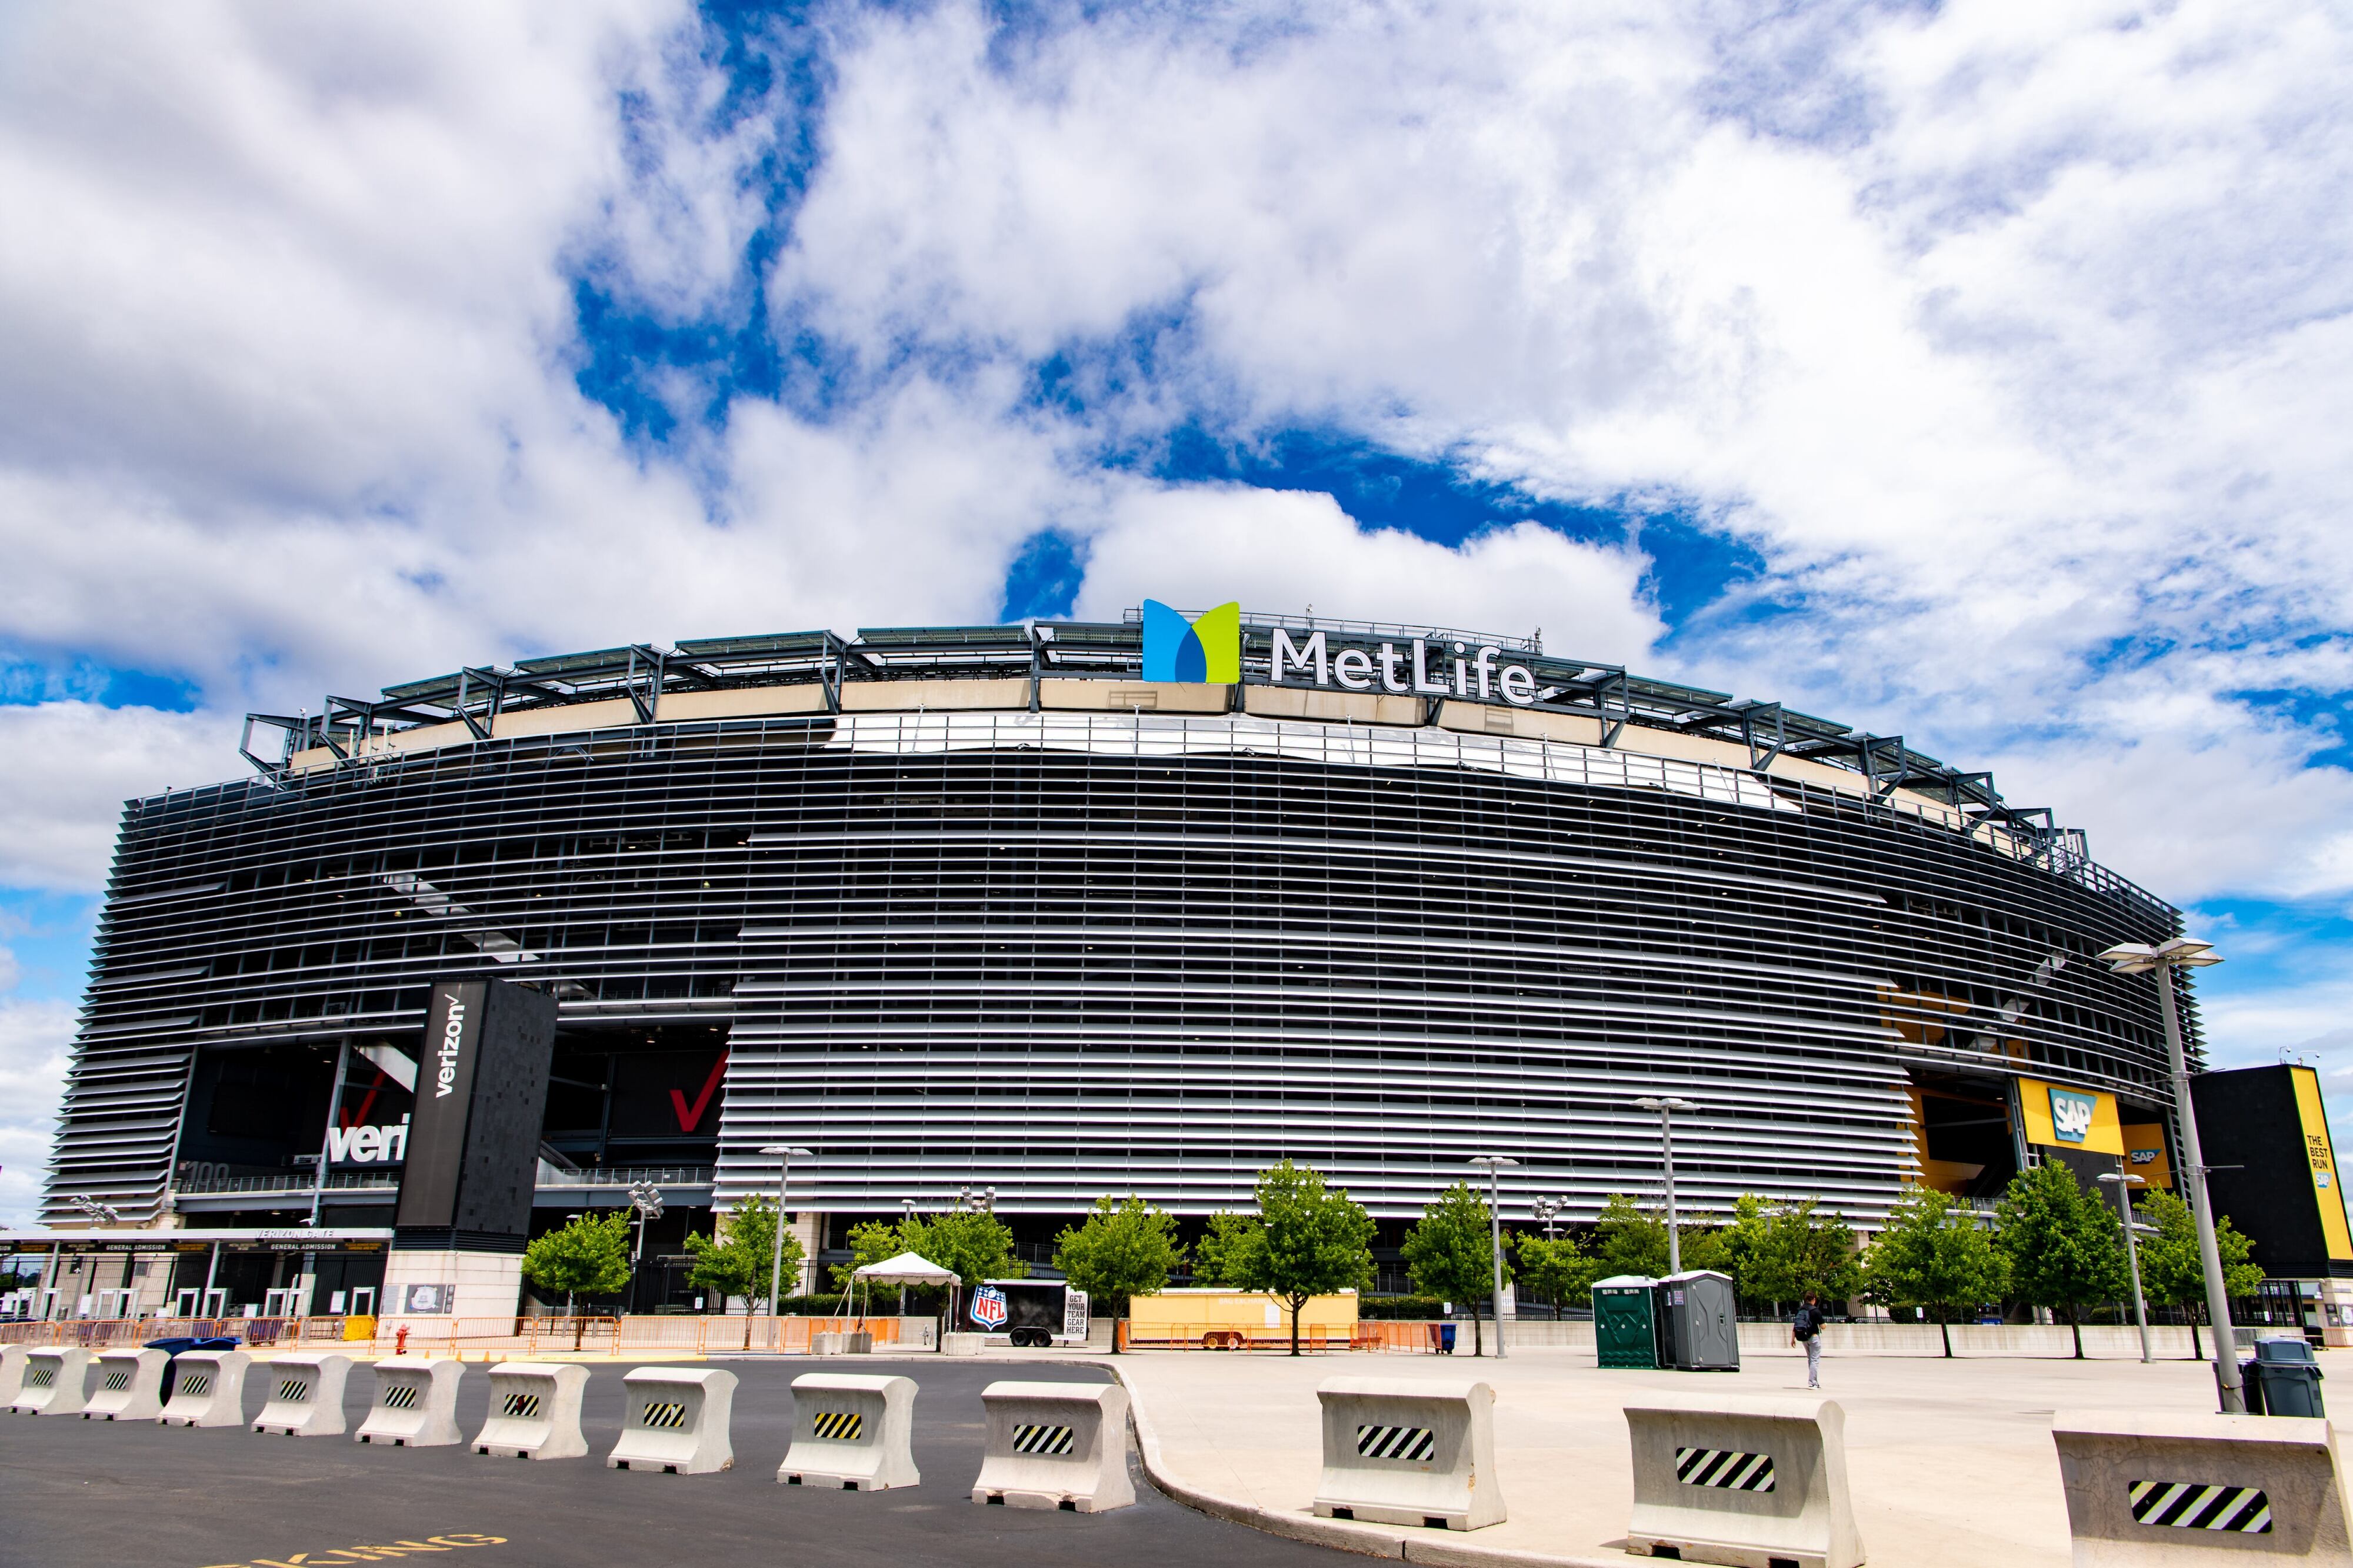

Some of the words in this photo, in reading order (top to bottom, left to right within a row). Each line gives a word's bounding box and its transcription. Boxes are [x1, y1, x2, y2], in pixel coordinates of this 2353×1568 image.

[1269, 627, 1537, 706] MetLife
[436, 1005, 465, 1098] verizon
[2054, 1097, 2091, 1135] SAP
[329, 1113, 411, 1162] veri
[2307, 1135, 2322, 1146] THE
[2131, 1152, 2155, 1162] SAP
[2309, 1147, 2328, 1158] BEST
[2312, 1159, 2328, 1169] RUN
[186, 1160, 229, 1187] 100
[2316, 1175, 2329, 1186] SAP
[256, 1229, 302, 1238] VERIZON
[306, 1230, 334, 1238] GATE
[976, 1297, 1005, 1320] NFL
[198, 1533, 508, 1568] KING
